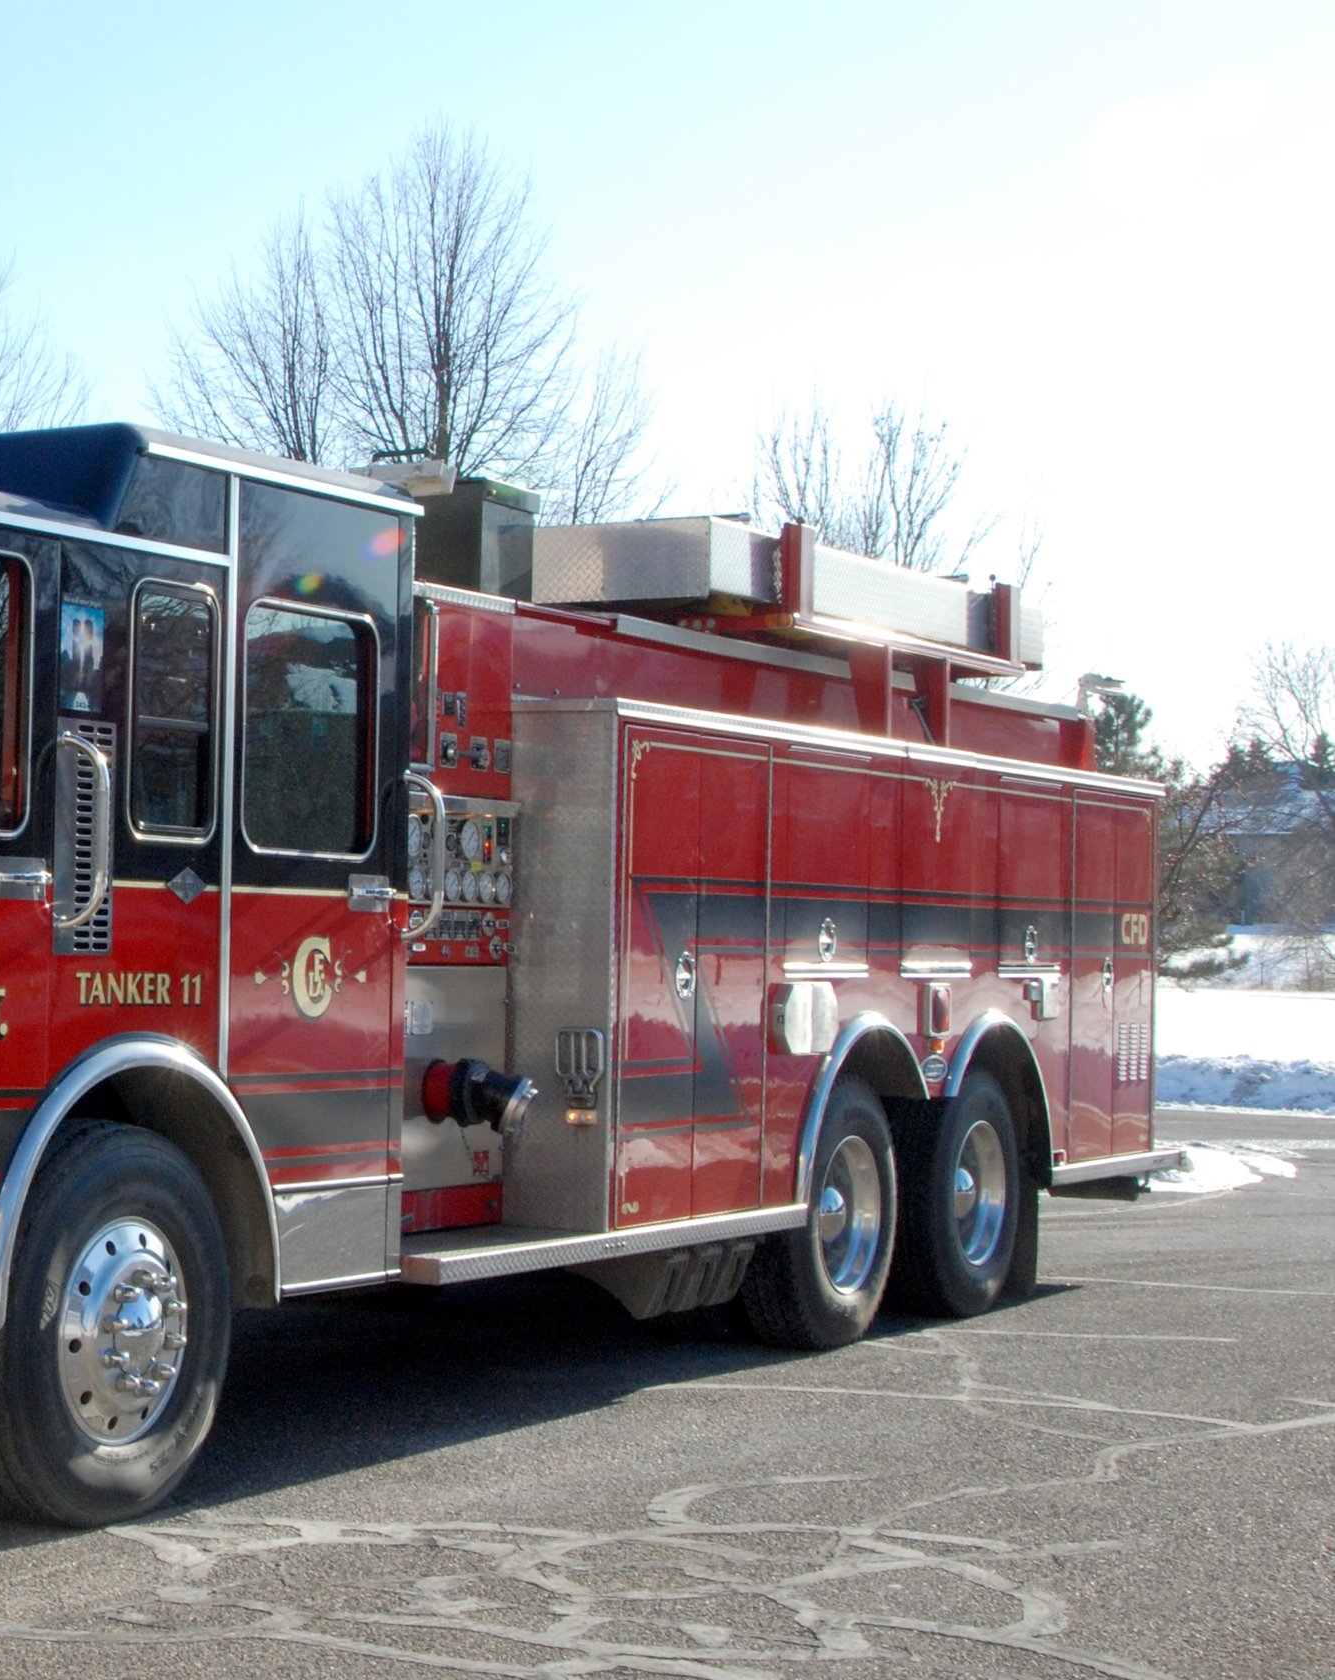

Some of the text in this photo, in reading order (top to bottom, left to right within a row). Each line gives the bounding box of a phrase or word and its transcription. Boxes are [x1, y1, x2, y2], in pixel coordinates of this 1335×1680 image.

[1121, 913, 1148, 945] CFD
[76, 971, 202, 1006] TANKER 11
